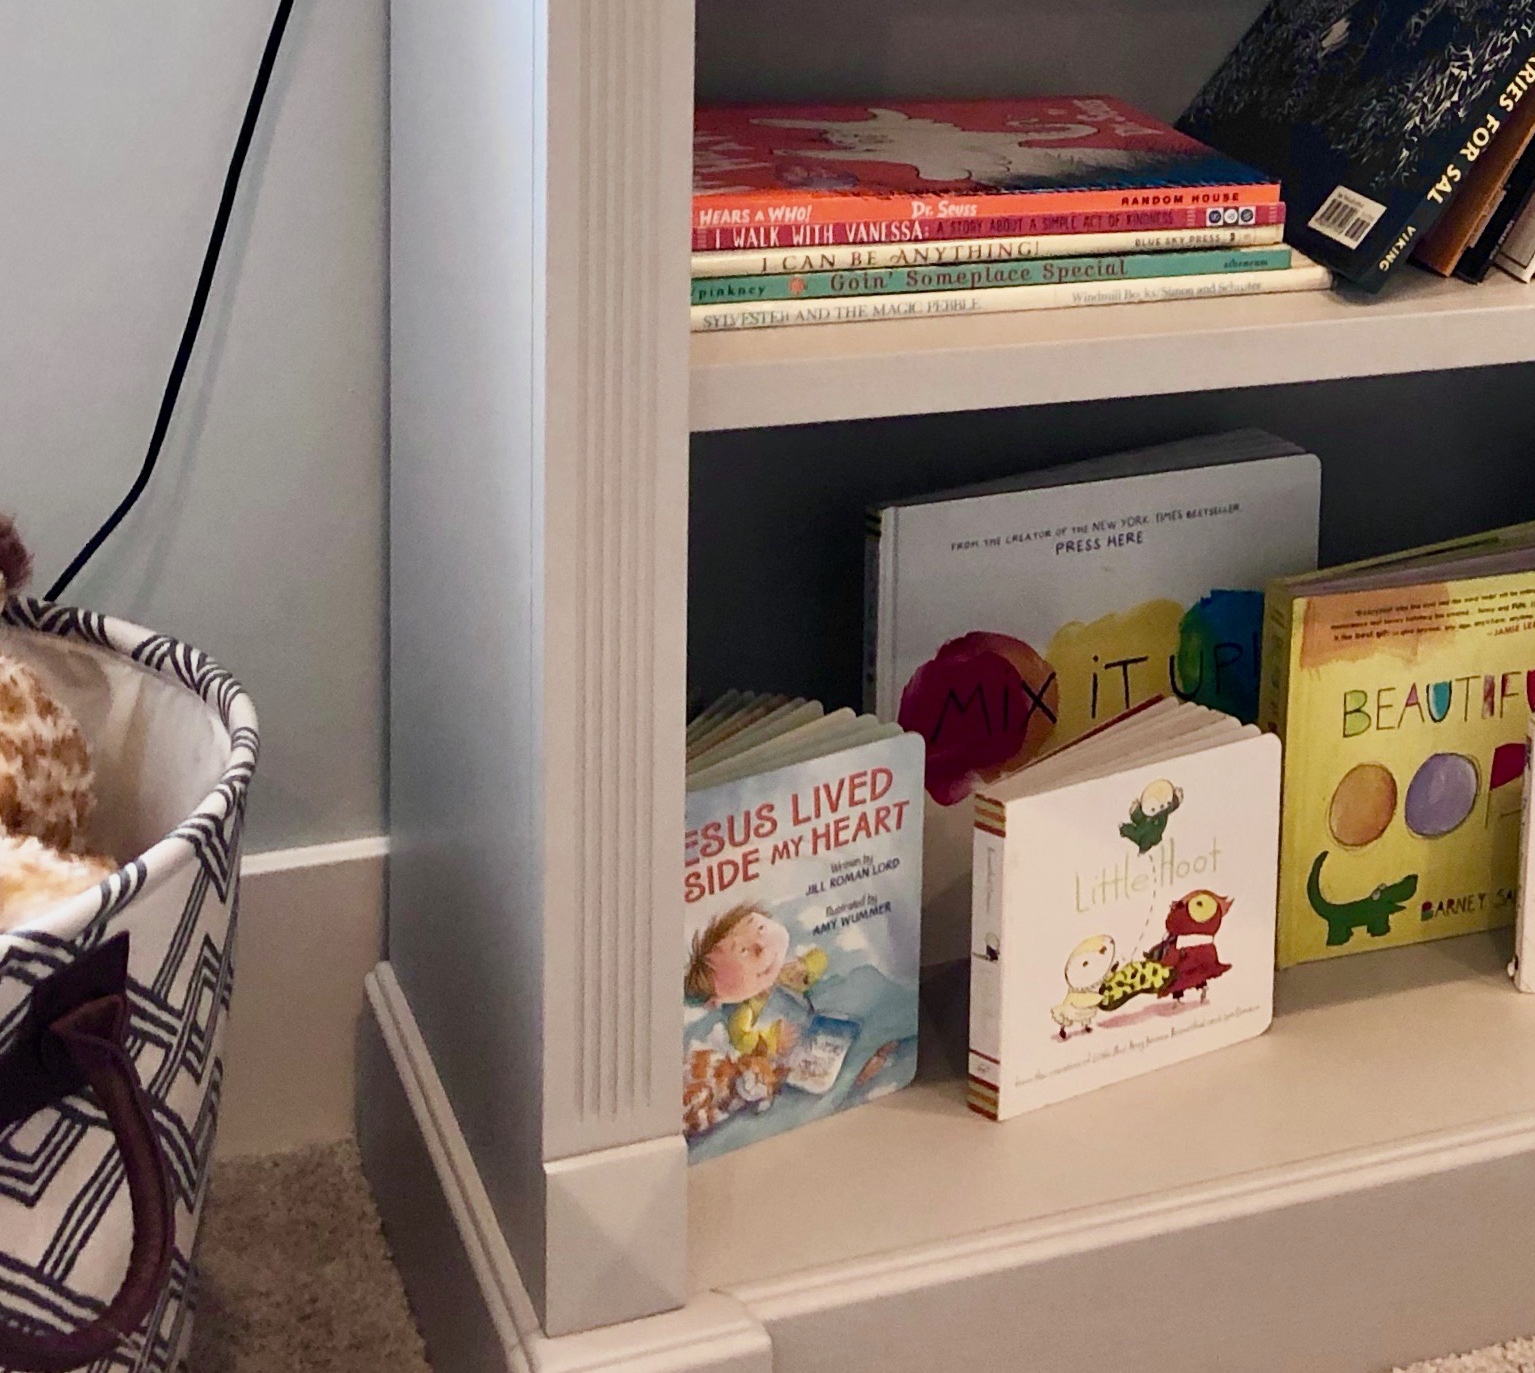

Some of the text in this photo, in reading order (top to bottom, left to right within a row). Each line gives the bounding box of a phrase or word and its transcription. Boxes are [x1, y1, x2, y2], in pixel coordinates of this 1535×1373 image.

[1458, 113, 1501, 161] FOR
[1122, 192, 1239, 207] RANDOM HOUSE
[1424, 163, 1463, 206] SAL
[700, 209, 749, 225] HEARS
[768, 205, 812, 222] WHO!
[911, 200, 977, 219] Dr. Seuss
[715, 220, 930, 248] I WALK WITH VANESSA:
[1377, 223, 1416, 273] VIKING
[761, 241, 1040, 272] I CAN BE ANYTHING!
[906, 267, 1031, 289] Someplace
[1042, 258, 1128, 283] Special
[1055, 531, 1144, 556] PRESS HERE
[930, 671, 1057, 744] MIX
[685, 767, 894, 868] ESUS LIVED
[684, 800, 911, 904] SIDE MY HEART
[805, 857, 900, 896] JILL ROMAN LORD
[1074, 836, 1222, 914] Little Hoot
[812, 901, 892, 936] AMY WUMMER
[1421, 892, 1486, 921] BARNEY
